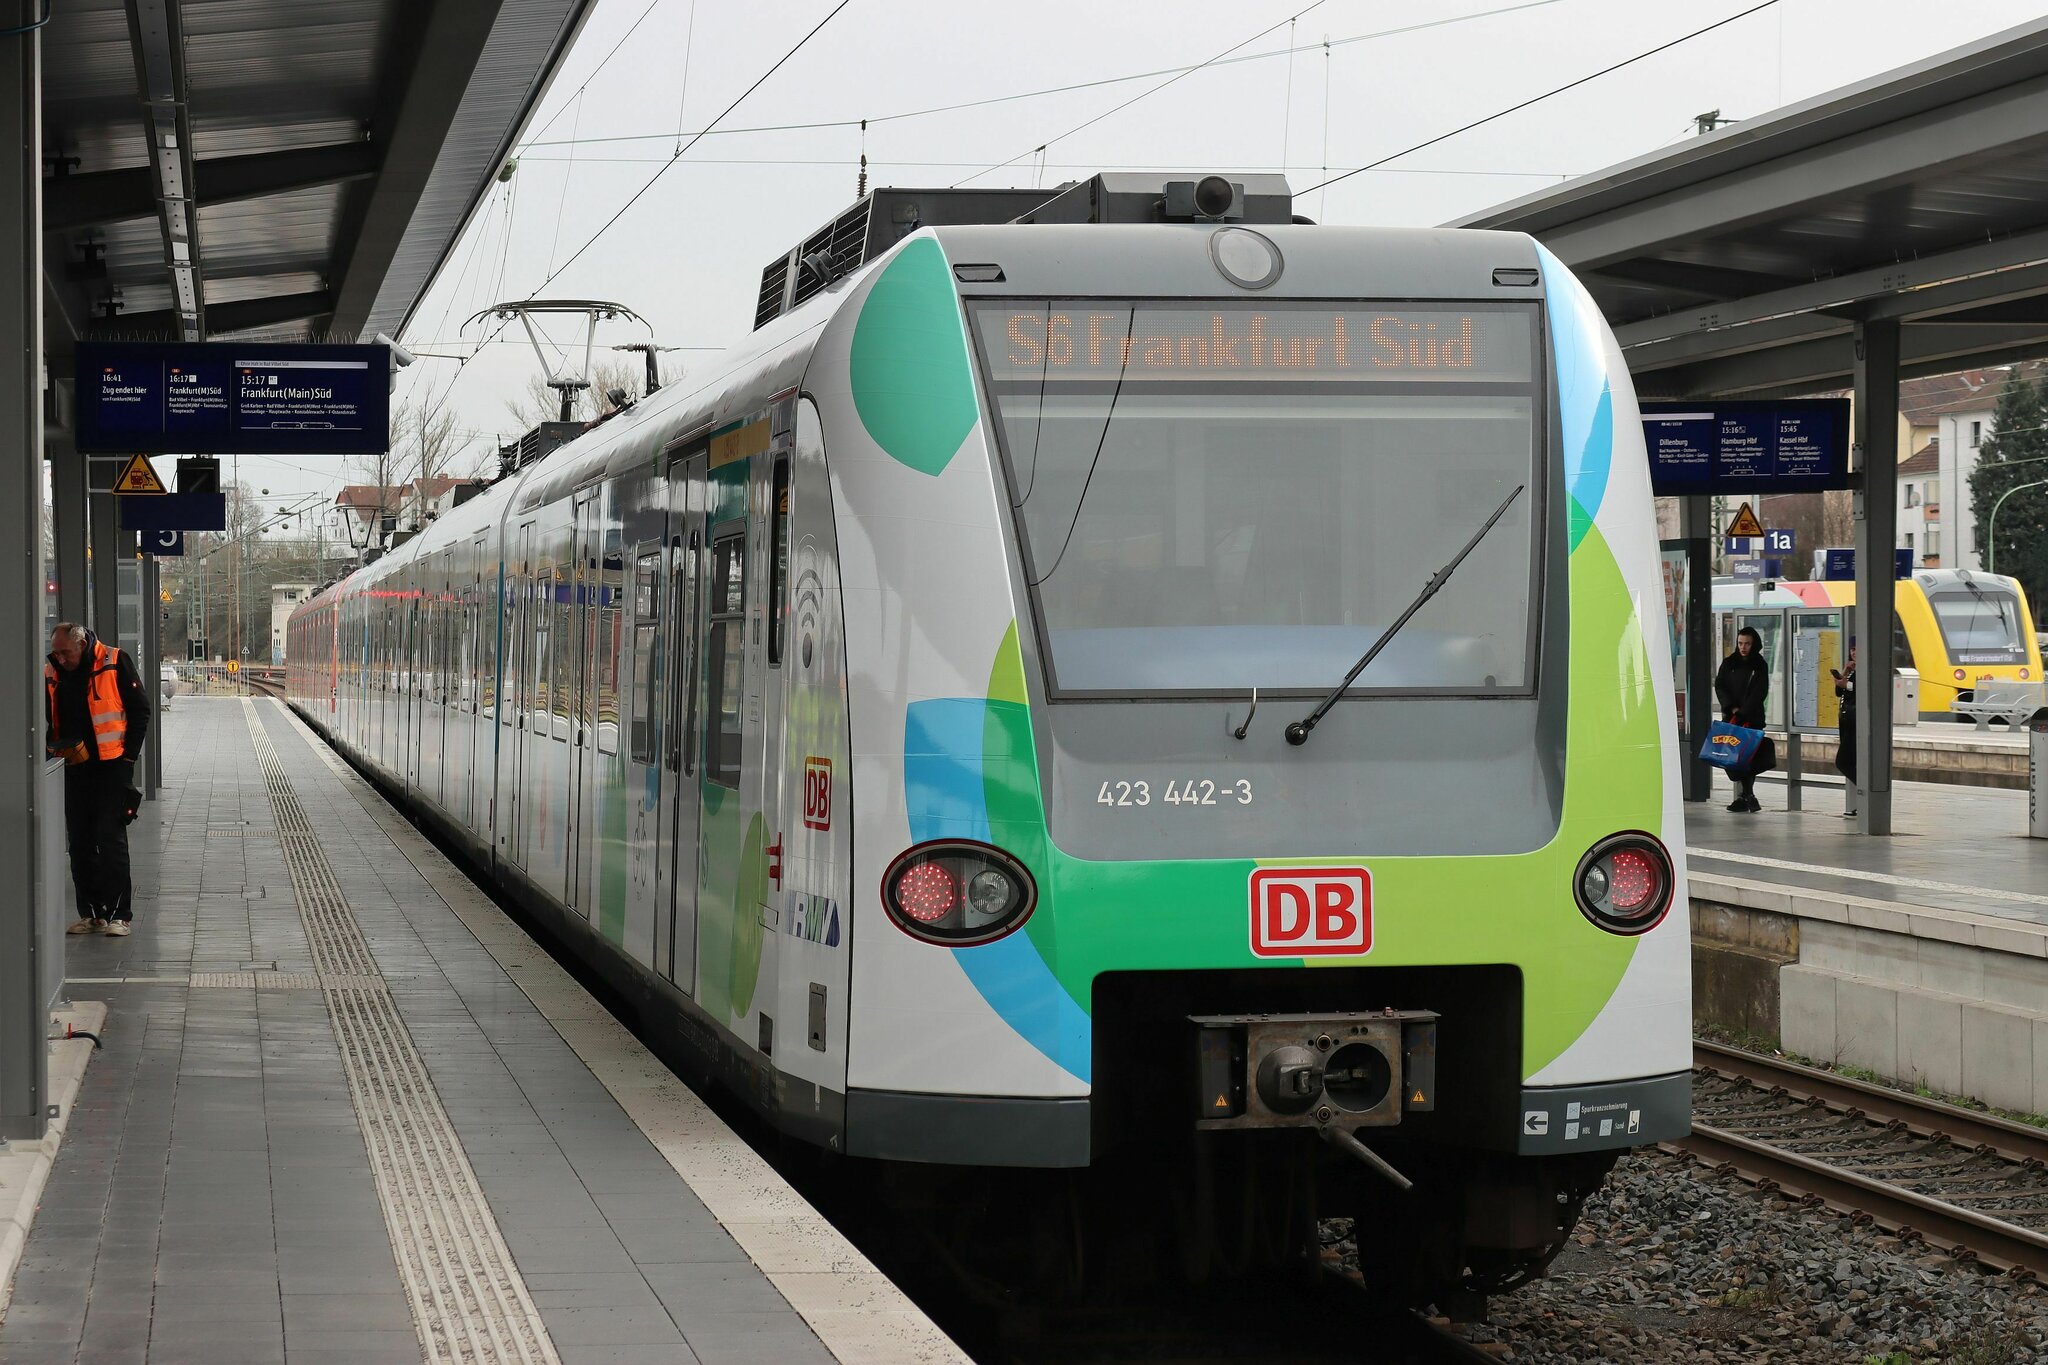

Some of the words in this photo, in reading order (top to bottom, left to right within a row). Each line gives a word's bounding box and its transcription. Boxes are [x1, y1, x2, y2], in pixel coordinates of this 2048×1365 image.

[1007, 314, 1072, 366] S6
[1088, 315, 1350, 367] Frankfurt
[1370, 316, 1472, 367] Süd
[241, 376, 265, 384] 15:17
[102, 386, 114, 395] Zug
[169, 387, 222, 395] Frankfurt(M)Süd
[241, 387, 332, 400] Frankfurt(Main)Süd
[1770, 531, 1791, 549] 1a
[806, 768, 828, 818] DB
[1097, 780, 1150, 806] 423
[1164, 779, 1253, 805] 442-3
[793, 891, 836, 945] RMV
[1267, 883, 1357, 941] DB
[1581, 1102, 1627, 1114] Spurkranzschmierung
[1615, 1122, 1625, 1130] Sand
